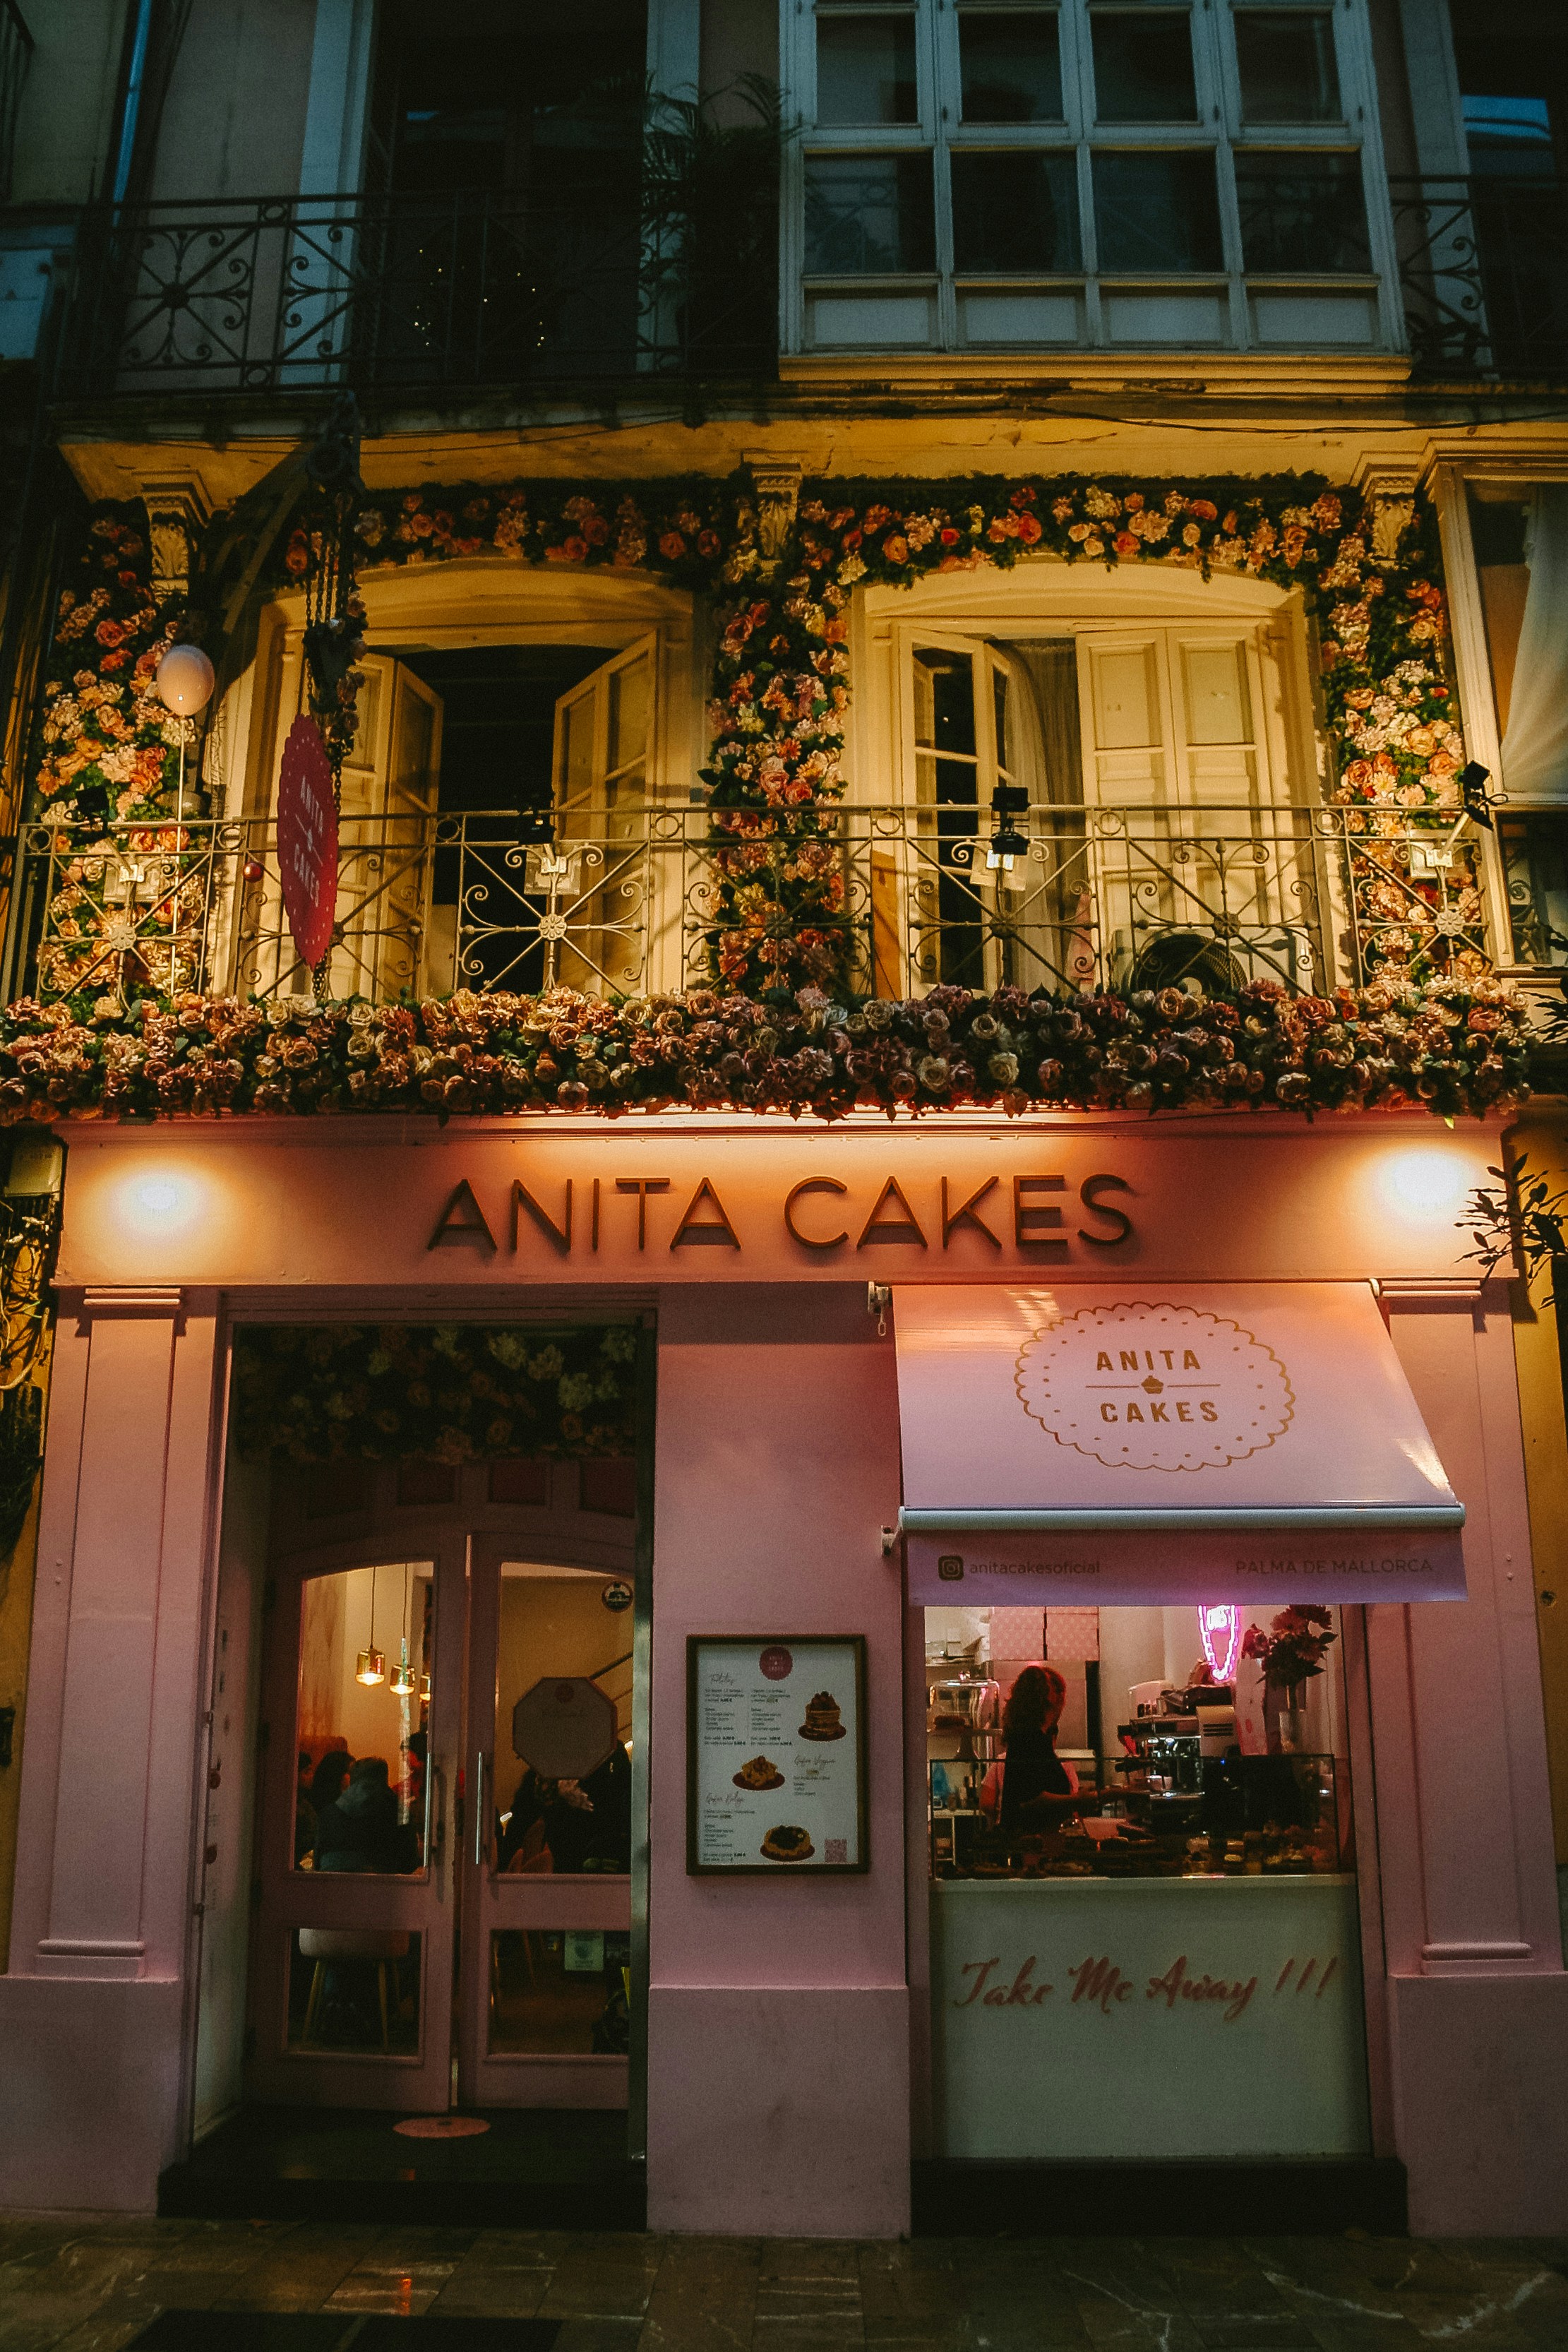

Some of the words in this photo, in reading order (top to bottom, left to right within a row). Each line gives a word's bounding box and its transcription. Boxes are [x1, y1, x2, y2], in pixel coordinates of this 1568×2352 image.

[300, 775, 323, 835] ANITA
[294, 842, 320, 908] CAKES
[429, 1178, 741, 1252] ANITA
[784, 1174, 1132, 1248] CAKES
[1096, 1349, 1202, 1371] ANITA
[1099, 1401, 1220, 1423] CAKES
[969, 1559, 1101, 1575] anitacakesoficial
[1235, 1560, 1297, 1575] PALMA
[1303, 1560, 1327, 1574] DE
[1332, 1559, 1433, 1574] MALLORCA
[954, 1955, 1054, 2007] Take
[1067, 1956, 1135, 2014] Me
[1145, 1955, 1258, 2022] Away
